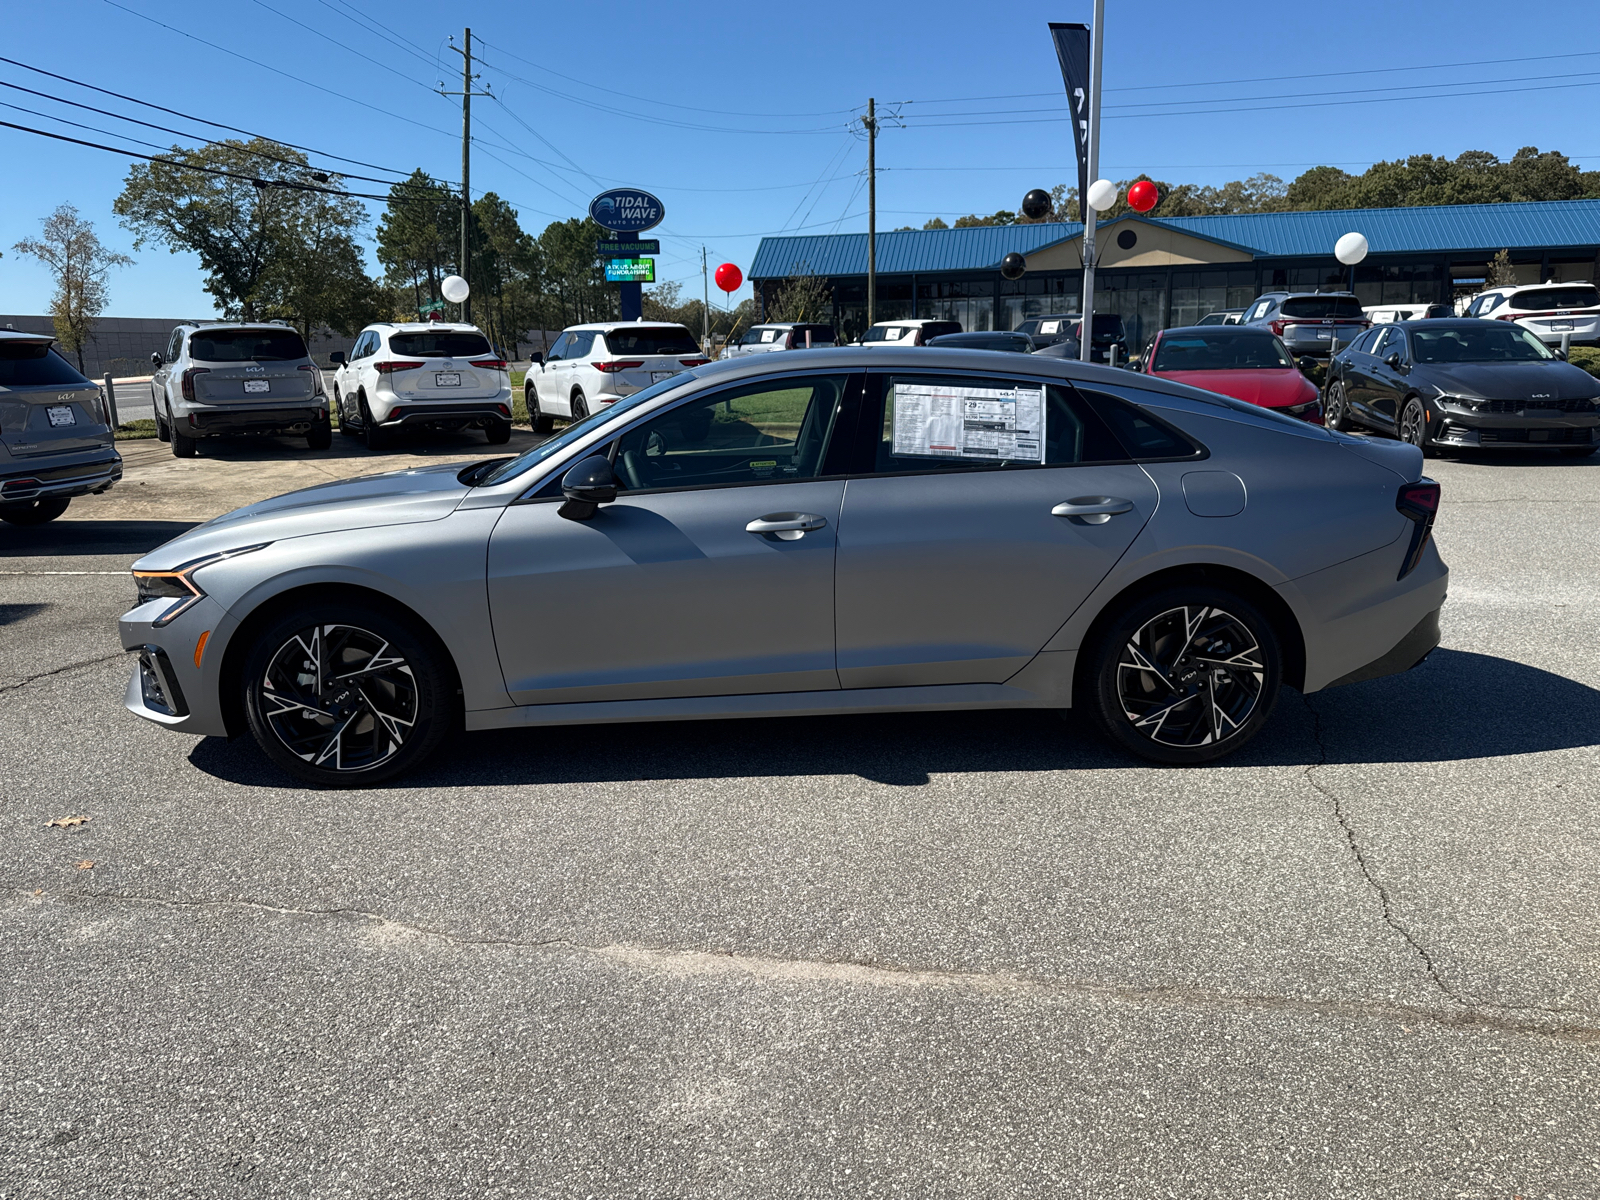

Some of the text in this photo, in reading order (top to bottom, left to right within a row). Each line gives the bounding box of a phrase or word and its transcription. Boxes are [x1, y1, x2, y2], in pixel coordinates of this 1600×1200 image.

[615, 197, 649, 208] TIDAL
[621, 208, 656, 219] WAVE
[600, 242, 655, 251] FREE VACUUMS
[968, 401, 977, 409] 29
[1181, 671, 1197, 681] KIA
[335, 691, 349, 703] KIA
